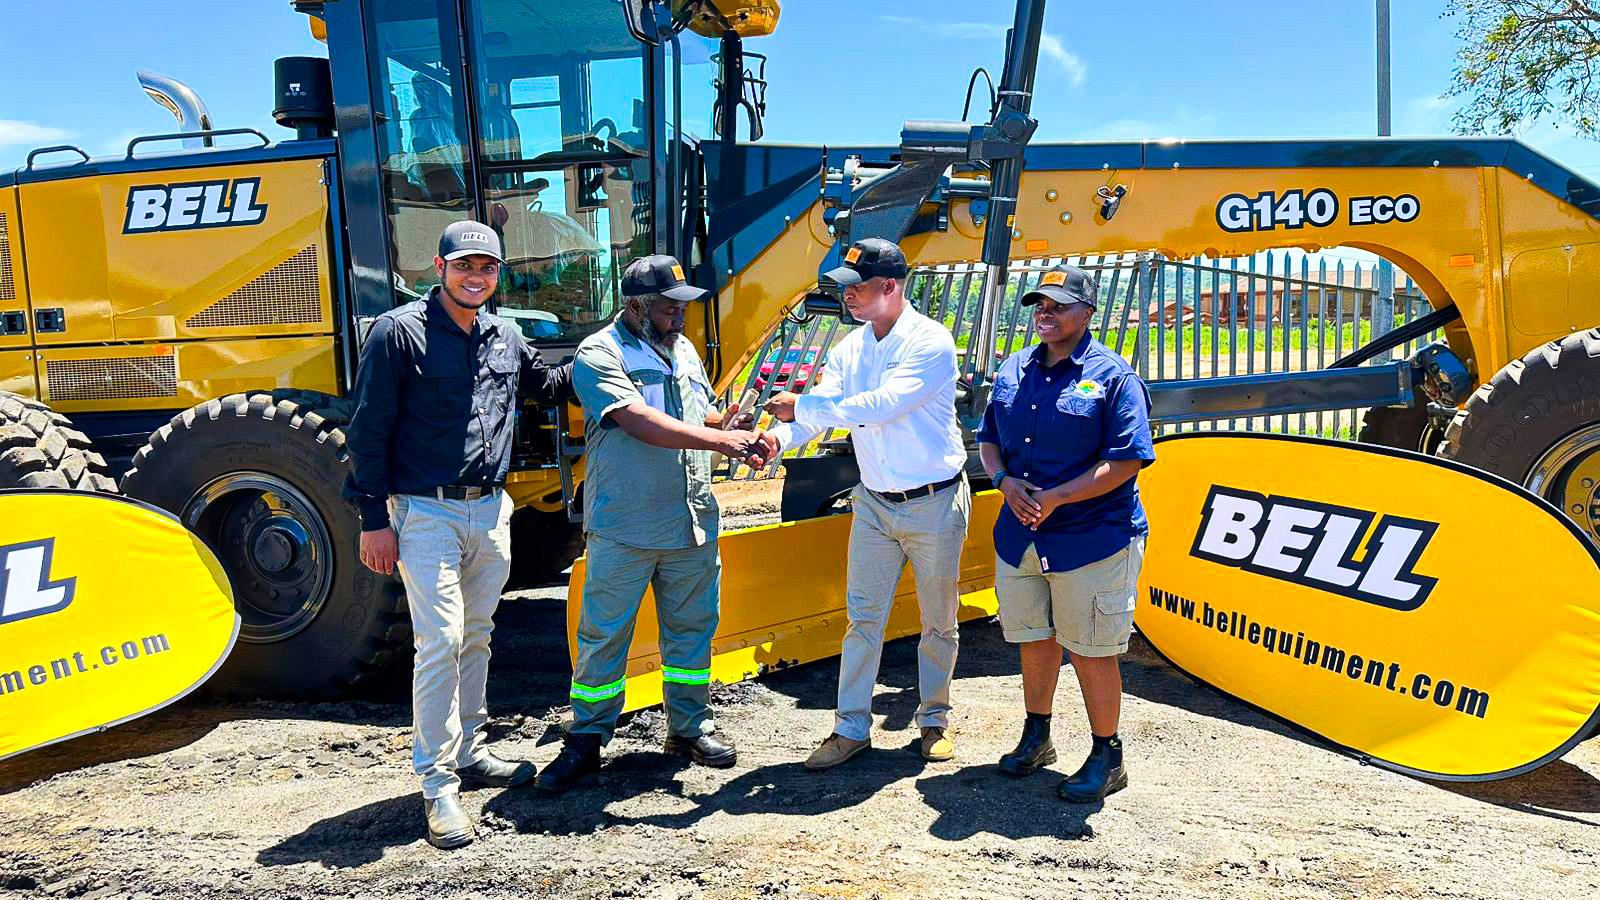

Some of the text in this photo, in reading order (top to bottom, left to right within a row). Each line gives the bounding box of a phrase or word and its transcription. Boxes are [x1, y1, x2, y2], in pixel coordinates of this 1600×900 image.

[124, 179, 266, 232] BELL
[1217, 189, 1419, 231] G140 ECO
[1194, 487, 1435, 608] BELL
[1149, 586, 1490, 719] www.bellequipment.com
